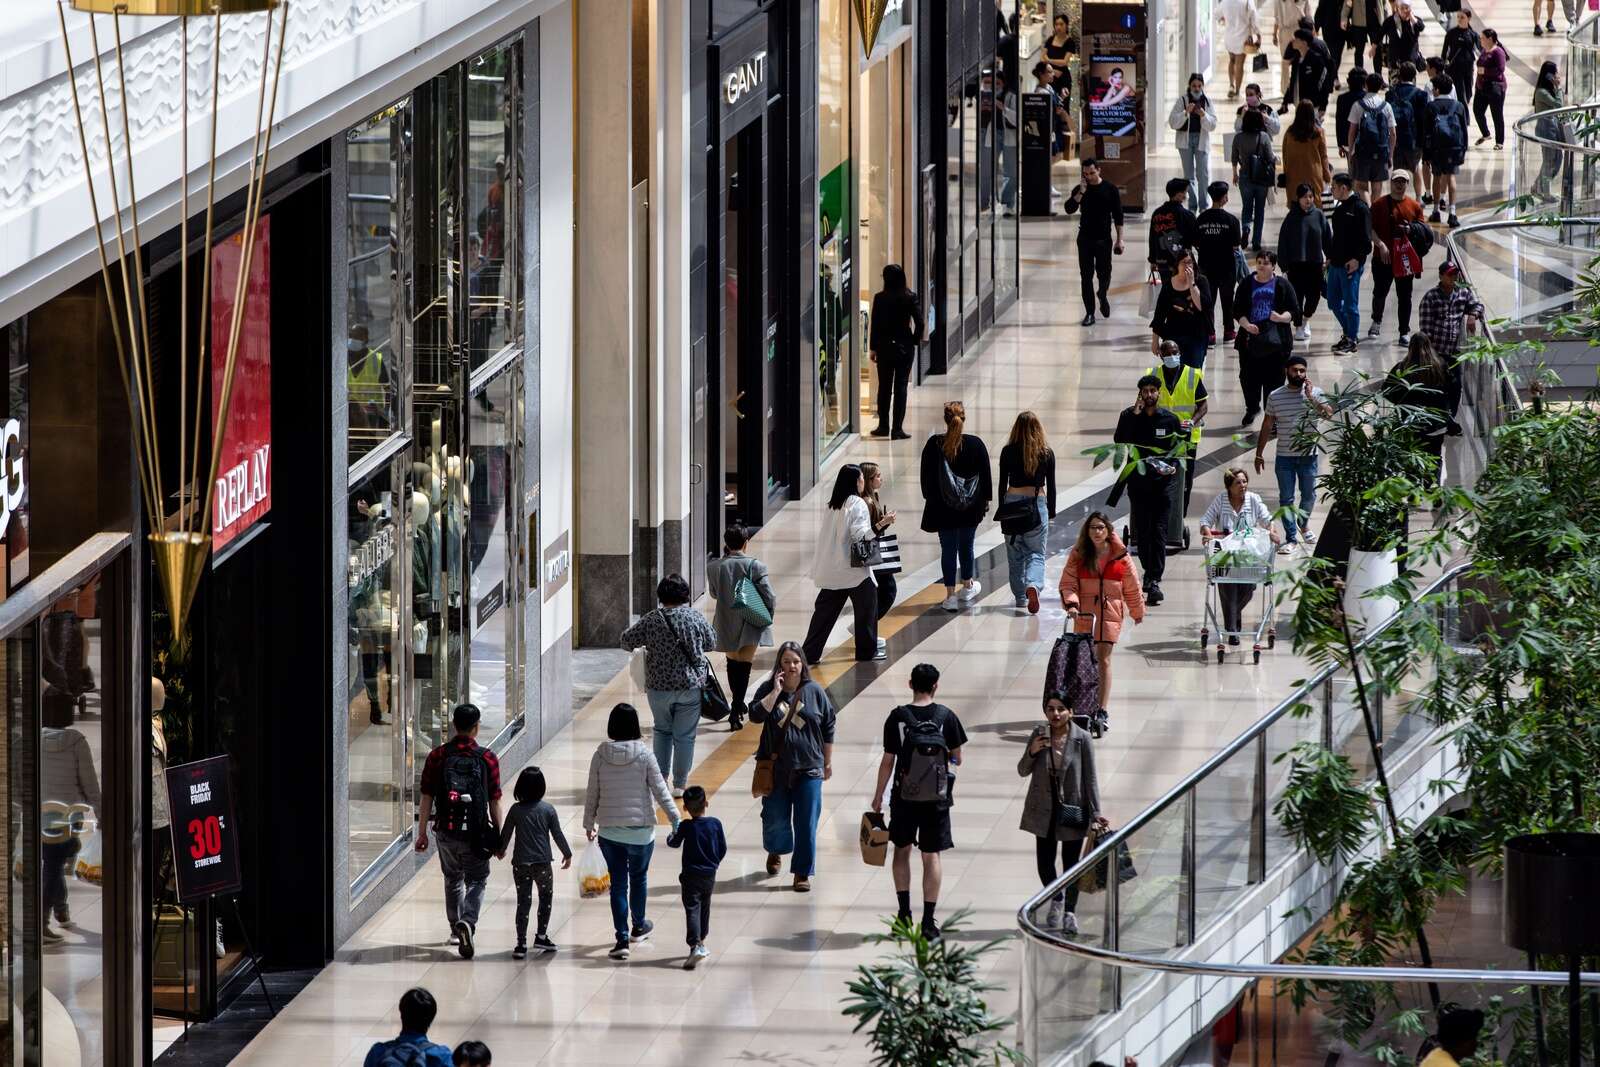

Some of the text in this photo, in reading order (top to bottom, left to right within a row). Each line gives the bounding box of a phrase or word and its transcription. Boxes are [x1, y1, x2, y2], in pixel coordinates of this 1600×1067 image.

[726, 51, 767, 104] GANT
[215, 444, 270, 533] REPLAY
[190, 781, 210, 795] BLACK
[190, 791, 211, 805] FRIDAY
[188, 815, 221, 860] 30
[195, 855, 221, 868] STOREWIDE
